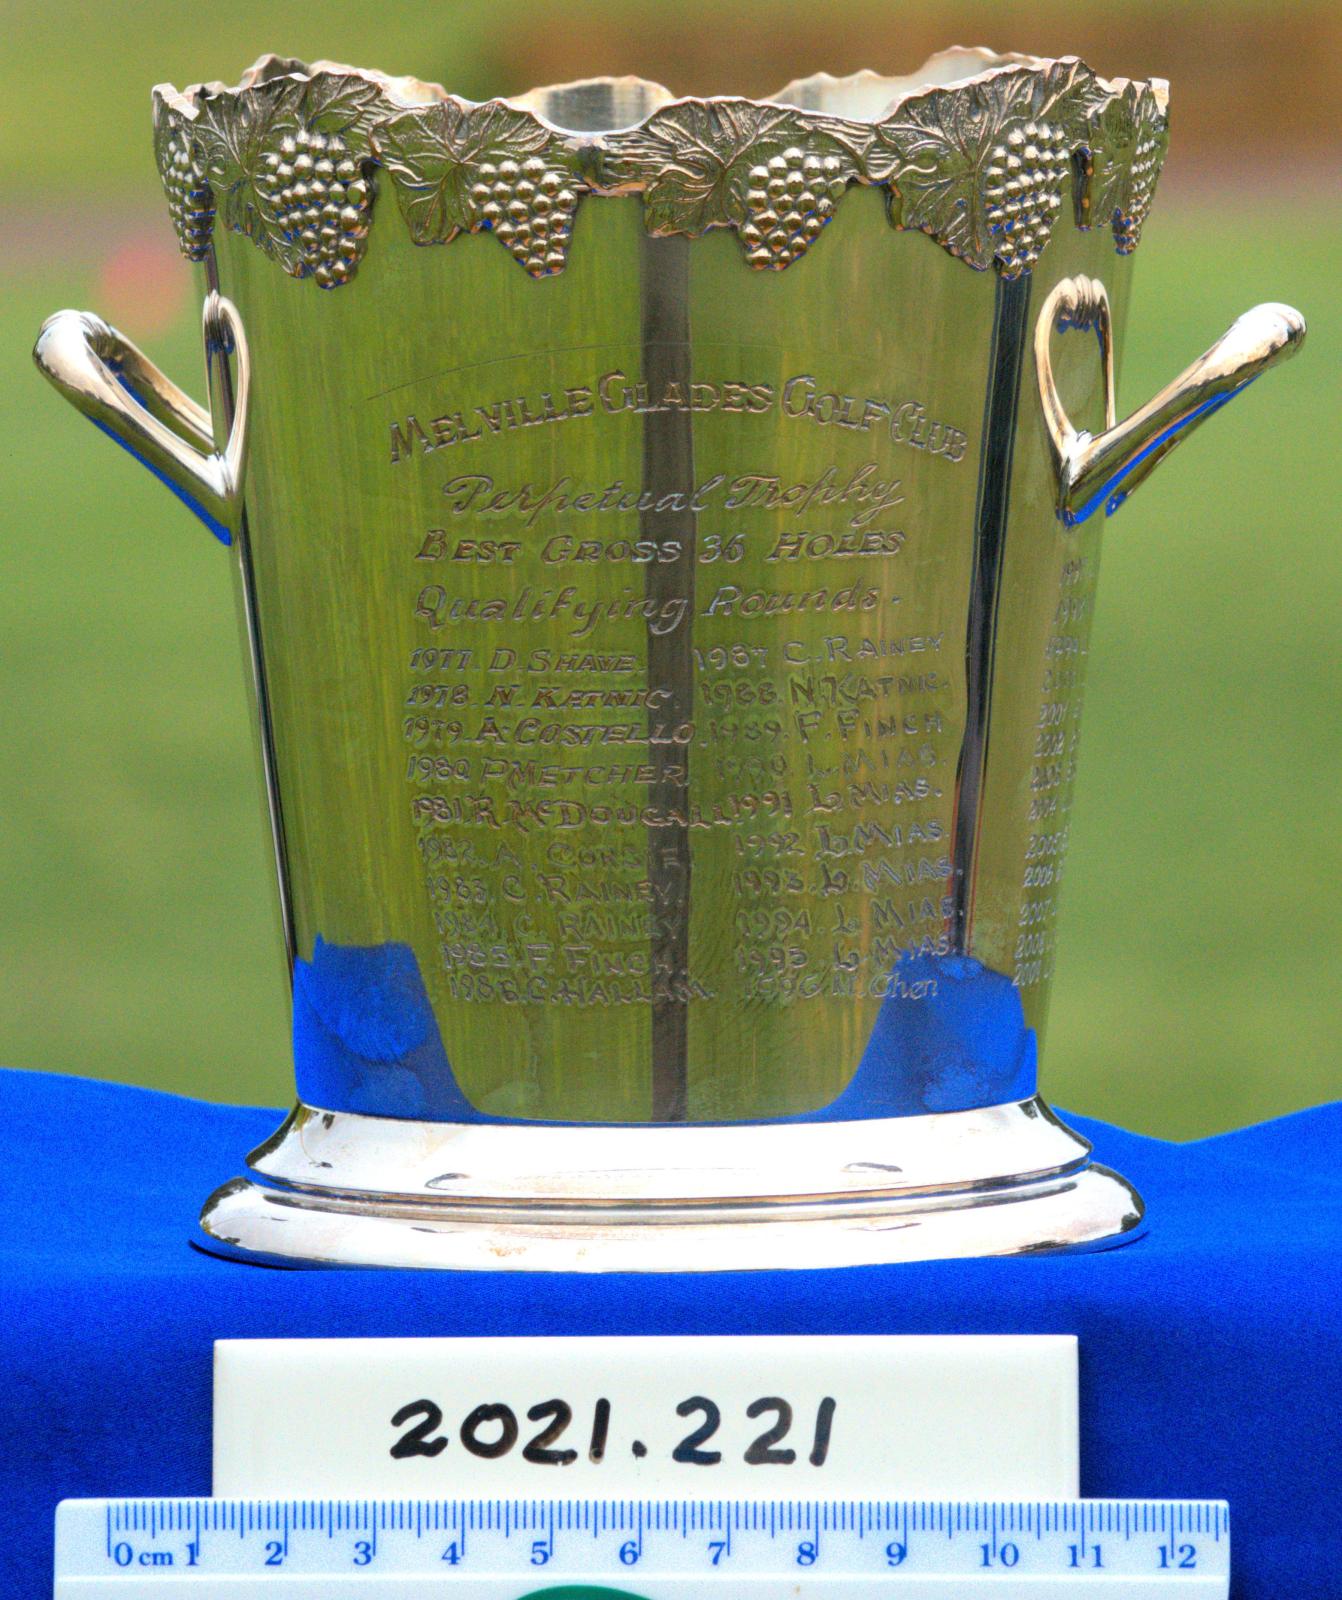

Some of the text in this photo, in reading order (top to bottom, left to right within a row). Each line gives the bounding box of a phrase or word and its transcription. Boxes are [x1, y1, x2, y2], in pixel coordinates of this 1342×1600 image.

[390, 369, 968, 464] MELVILLE GLADES GOLF CLUB
[443, 463, 905, 528] Perpetual Trophy
[415, 529, 906, 564] BEST GROSS 36 HOLES
[415, 584, 689, 637] Qualifying
[390, 1396, 836, 1466] 2021.221
[138, 1549, 173, 1566] cm
[264, 1543, 283, 1566] 2
[353, 1543, 371, 1566] 3
[441, 1543, 460, 1566] 4
[530, 1542, 548, 1565] 5
[618, 1542, 638, 1565] 6
[707, 1542, 725, 1565] 7
[796, 1542, 816, 1565] 8
[886, 1542, 905, 1565] 9
[981, 1542, 1019, 1566] 10
[1069, 1542, 1104, 1567] 11
[1158, 1543, 1197, 1568] 12
